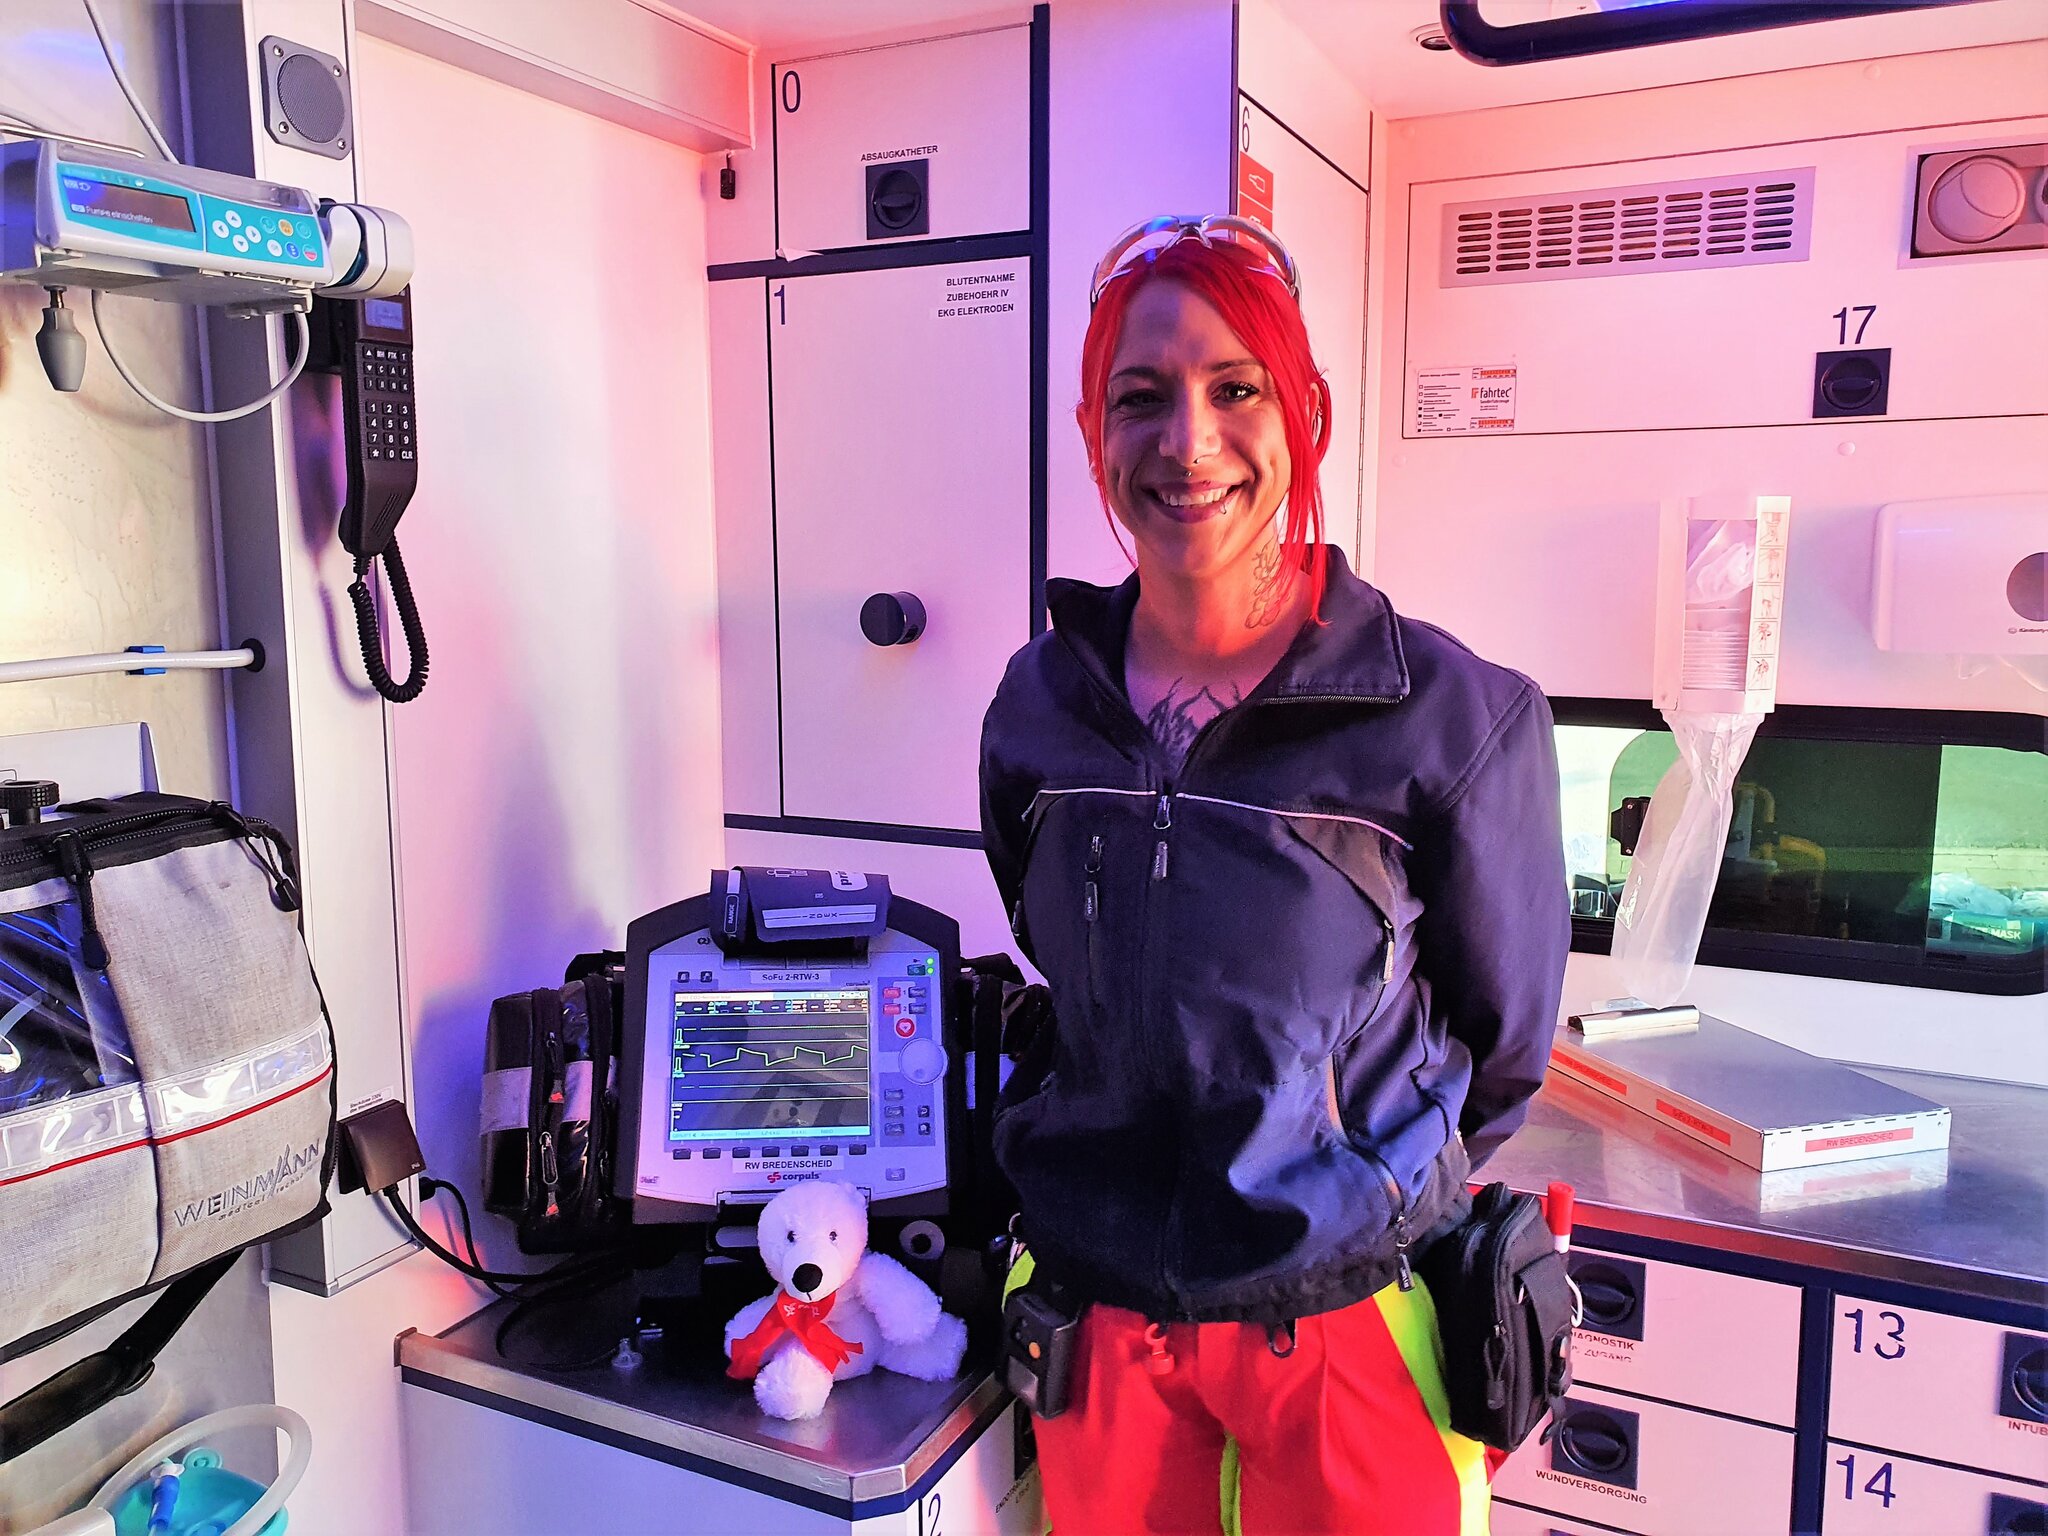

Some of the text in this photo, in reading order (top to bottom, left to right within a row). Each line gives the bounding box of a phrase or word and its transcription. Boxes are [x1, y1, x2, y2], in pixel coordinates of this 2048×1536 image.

[782, 70, 801, 113] 0
[1241, 106, 1250, 152] 6
[860, 145, 938, 162] ABSAUGKATHETER
[946, 273, 1016, 287] BLUTENTNAHME
[946, 289, 1010, 302] ZUBEHOEHR IV
[774, 284, 785, 325] 1
[937, 303, 1014, 318] EKG ELEKTRODEN
[1832, 305, 1877, 345] 17
[1479, 387, 1511, 399] fahrtec
[370, 403, 408, 414] 1 2 3
[371, 418, 409, 429] 4 5 6
[372, 433, 409, 444] 7 8 9
[389, 449, 413, 459] 0 CLR
[1990, 929, 2021, 940] MASK
[762, 972, 820, 981] SoFu 2-RTW-3
[745, 1160, 833, 1170] RW BREDENSCHEID
[174, 1138, 320, 1227] WEINMANN
[782, 1172, 820, 1181] corpuls
[218, 1195, 265, 1221] medical
[1571, 1331, 1635, 1351] IAGNOSTIK
[1844, 1308, 1906, 1360] 13
[1535, 1469, 1648, 1505] WUNDVERSORGUNG
[1836, 1454, 1896, 1509] 14
